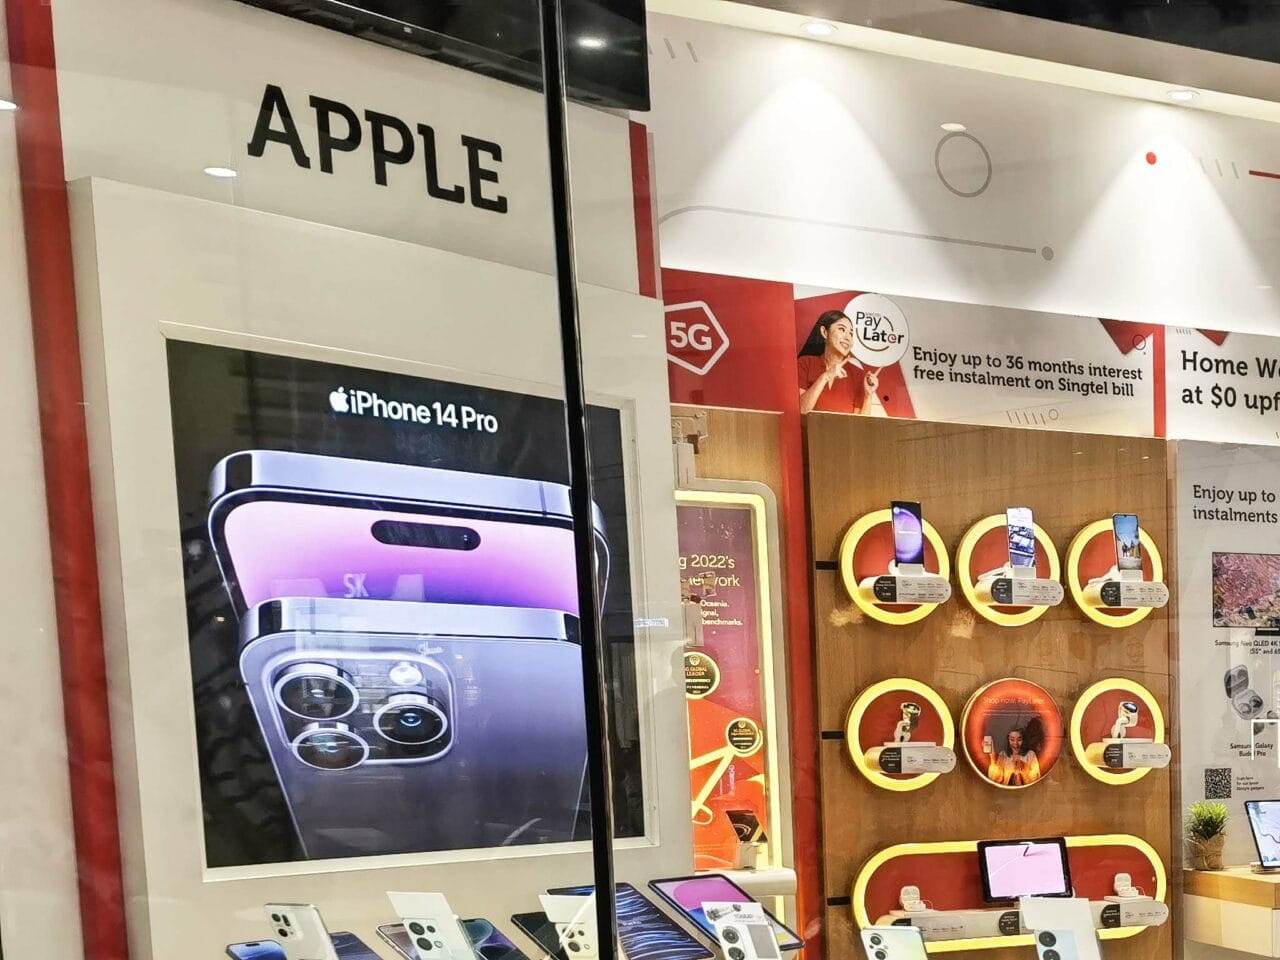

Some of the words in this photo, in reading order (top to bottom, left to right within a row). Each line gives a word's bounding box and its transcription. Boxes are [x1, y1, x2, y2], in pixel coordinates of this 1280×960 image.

[247, 84, 508, 214] APPLE
[856, 312, 881, 331] Pay
[670, 321, 712, 351] 5G
[863, 327, 904, 344] Later
[912, 346, 956, 367] Enjoy
[961, 353, 983, 370] up
[985, 352, 1003, 367] to
[1006, 355, 1024, 371] 36
[1027, 357, 1083, 376] months
[1088, 361, 1142, 380] interest
[1181, 350, 1248, 377] Home
[913, 365, 944, 382] free
[949, 370, 1031, 390] instalment
[1034, 377, 1054, 391] on
[1058, 377, 1106, 397] Singtel
[1110, 381, 1135, 397] bill
[1182, 385, 1203, 405] at
[1211, 384, 1238, 410] $0
[350, 389, 432, 424] iPhone
[433, 402, 458, 427] 14
[462, 406, 498, 433] Pro
[1193, 484, 1234, 503] Enjoy
[1238, 491, 1257, 504] up
[1261, 490, 1276, 502] to
[1193, 506, 1278, 524] instalments
[691, 554, 735, 569] 2022's
[1230, 742, 1252, 750] Samsun
[1255, 742, 1273, 750] Galaxy
